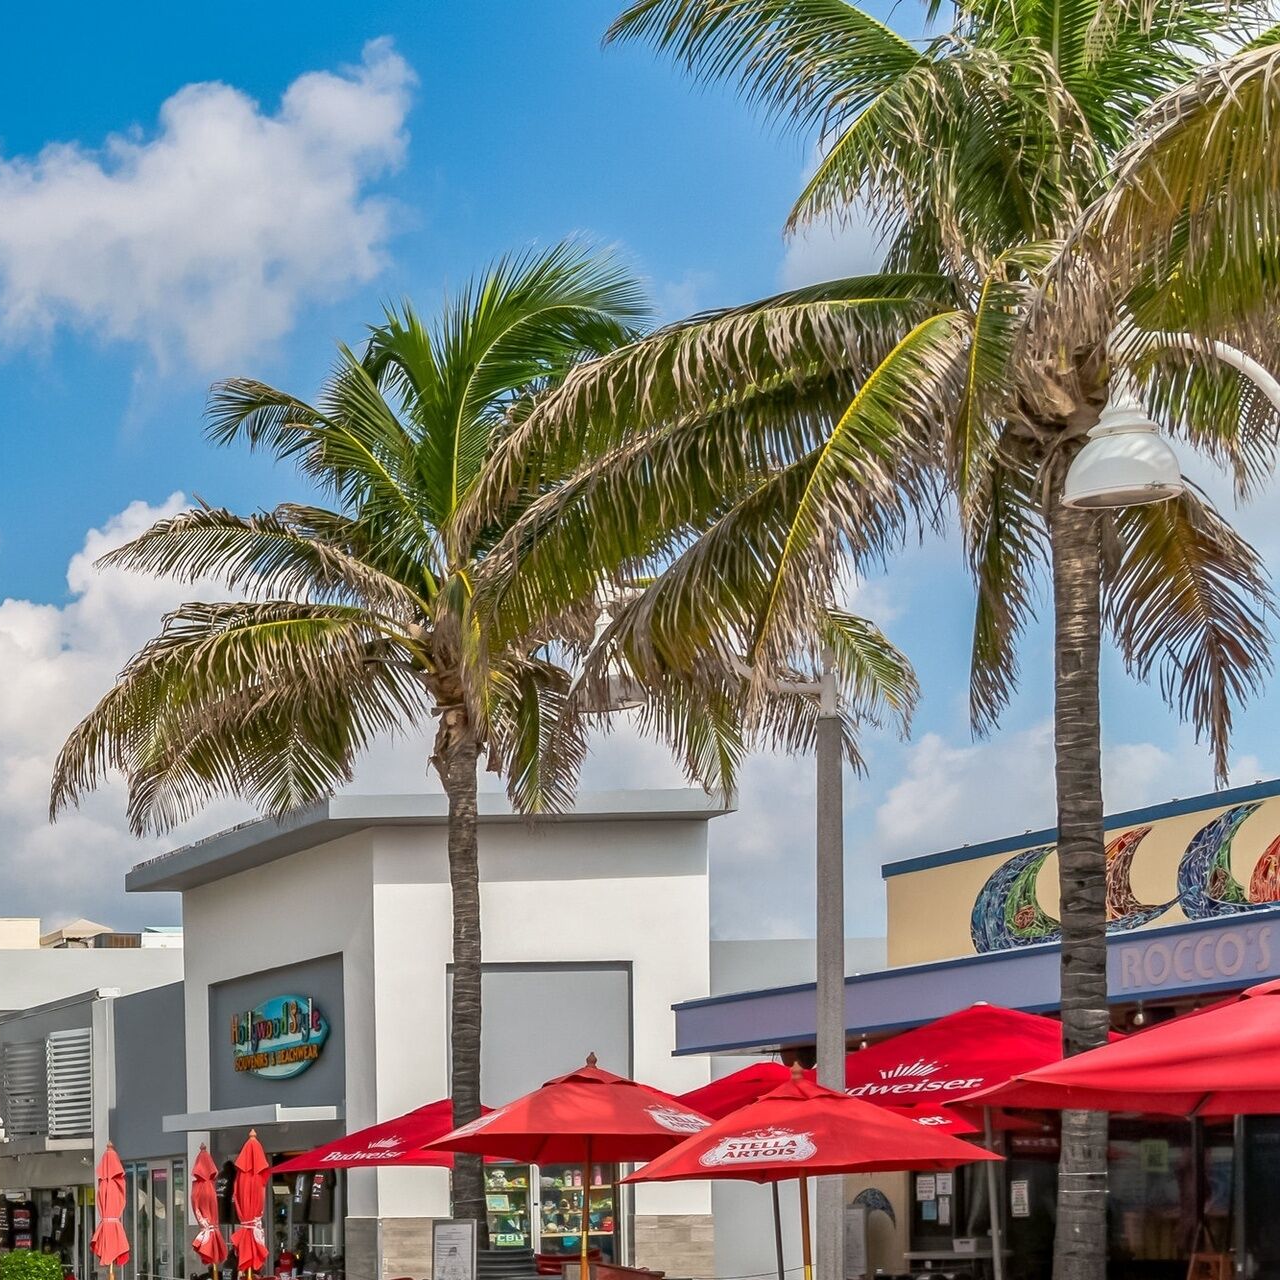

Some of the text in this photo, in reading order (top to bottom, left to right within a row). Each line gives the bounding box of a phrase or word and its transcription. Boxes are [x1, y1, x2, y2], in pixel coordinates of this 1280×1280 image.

[1120, 926, 1272, 989] ROCCO'S
[231, 997, 321, 1052] Hollywood Style
[277, 1045, 318, 1065] BEACHWEAR
[721, 1148, 797, 1159] ARTOIS
[726, 1140, 798, 1151] STELLA
